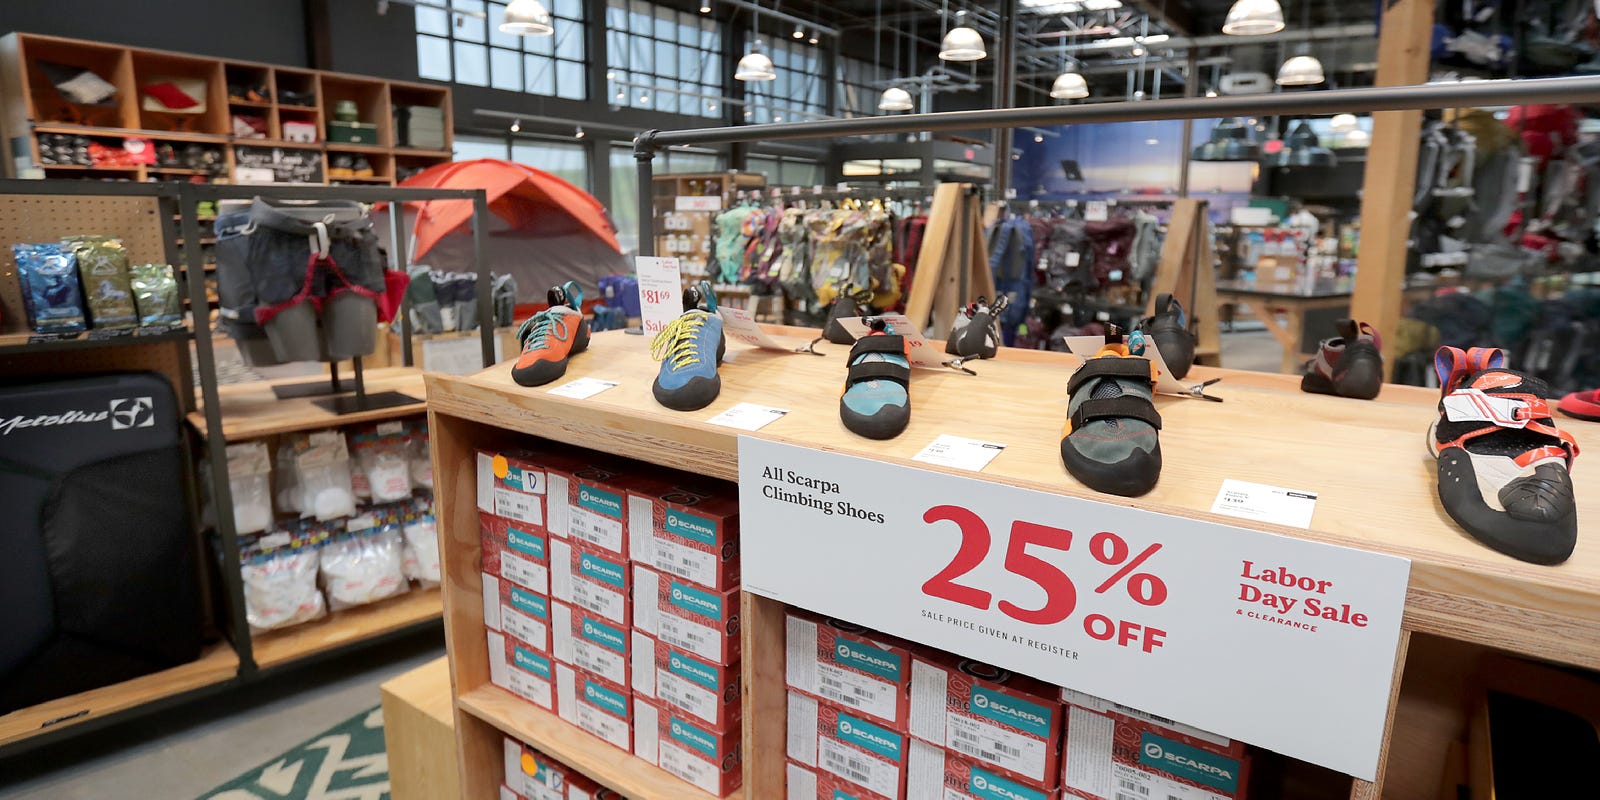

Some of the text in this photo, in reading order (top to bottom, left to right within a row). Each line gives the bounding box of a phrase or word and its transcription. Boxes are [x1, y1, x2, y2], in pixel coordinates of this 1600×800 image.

[528, 472, 537, 489] D
[762, 466, 840, 494] All Scarpa
[589, 495, 620, 509] SCARPA
[762, 485, 885, 524] Climbing Shoes
[678, 520, 714, 537] SCARPA
[591, 563, 621, 579] SCARPA
[921, 504, 1168, 625] 25%
[1241, 560, 1333, 594] Labor
[682, 595, 718, 612] SCARPA
[1238, 583, 1368, 627] Day Sale
[1083, 613, 1168, 654] OFF
[1247, 611, 1318, 632] CLEARANCE
[921, 609, 1079, 660] SALE PRICE GIVEN AT REGISTER
[681, 663, 716, 682] SCARPA
[851, 650, 897, 671] SCARPA
[990, 701, 1046, 725] SCARPA
[681, 729, 715, 750] SCARPA
[852, 727, 898, 751] SCARPA
[1164, 752, 1233, 780] SCARPA
